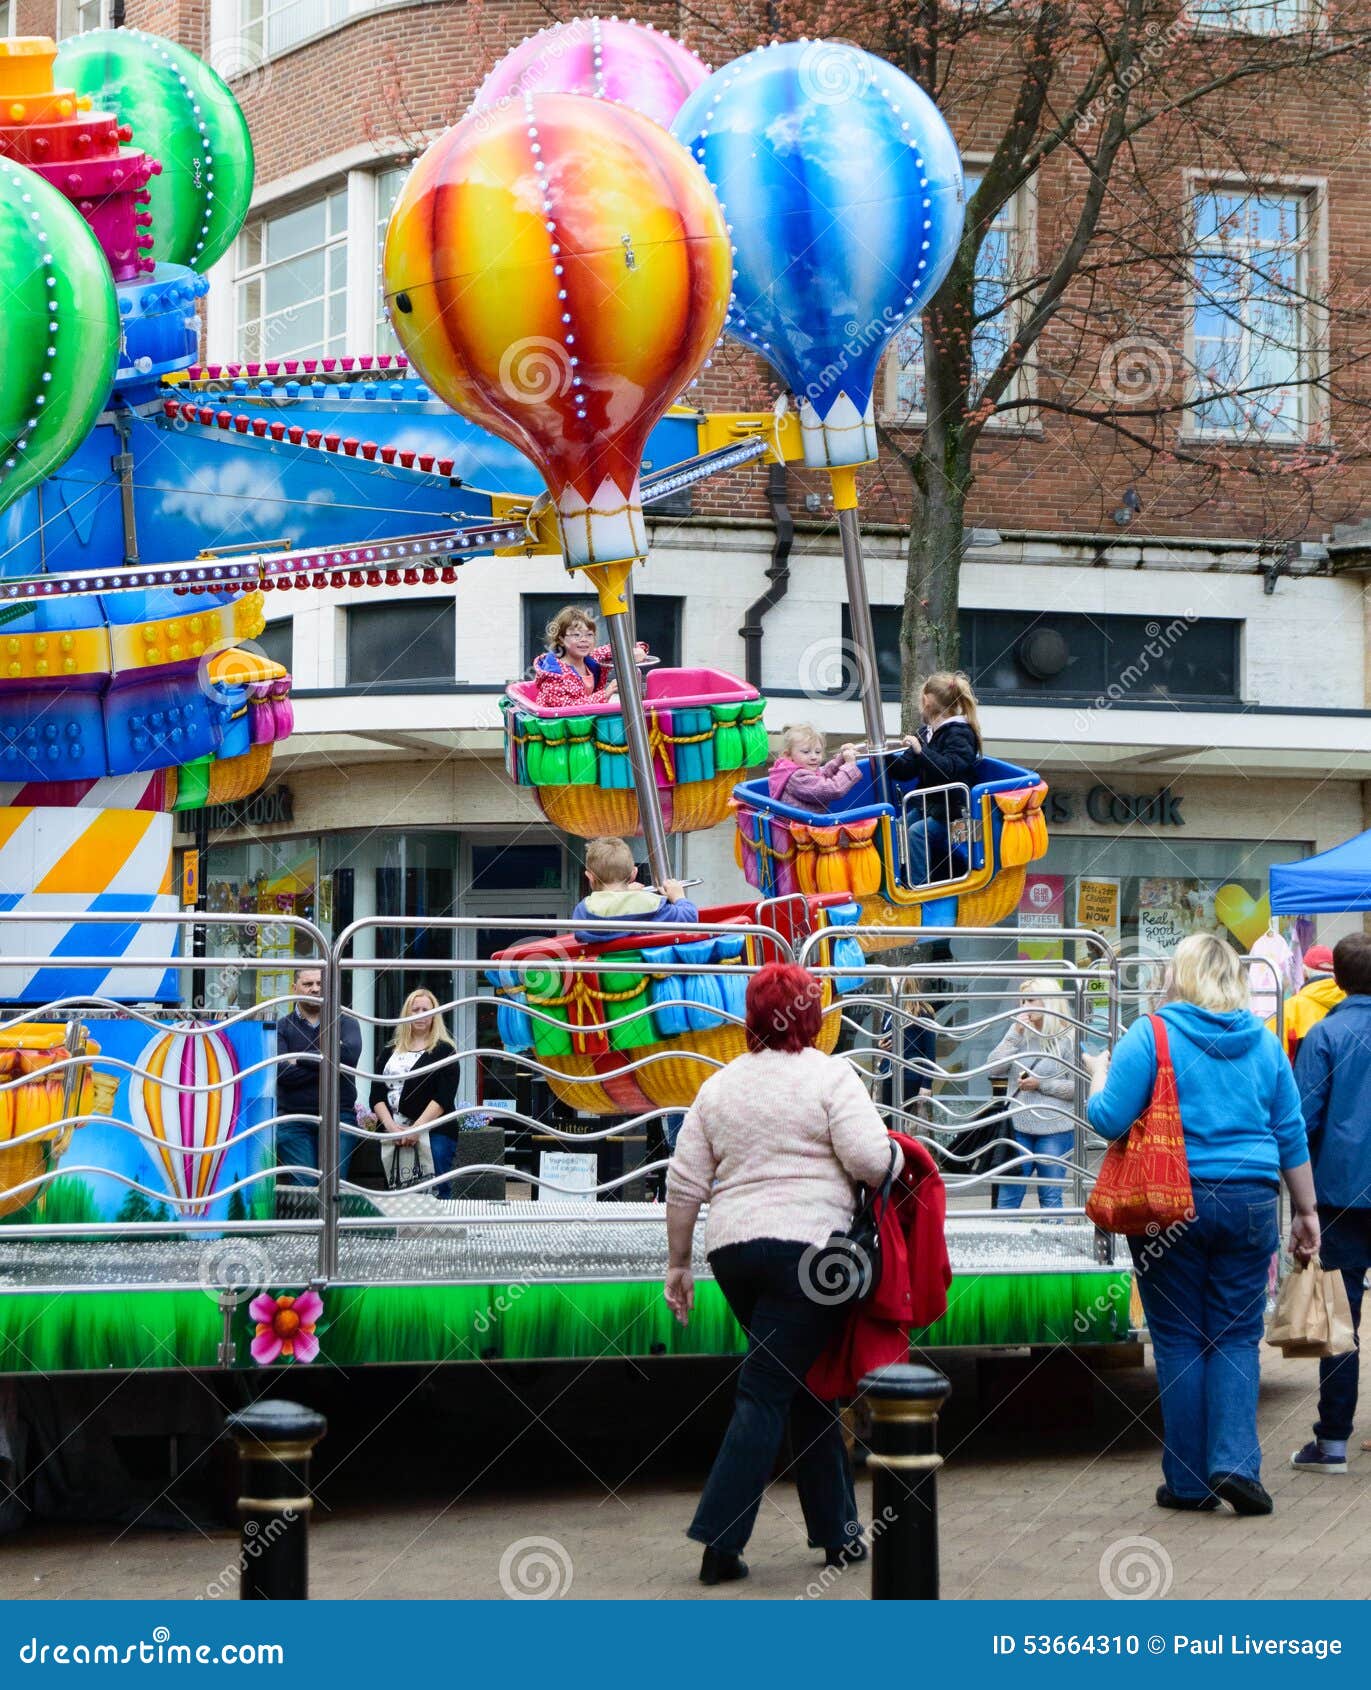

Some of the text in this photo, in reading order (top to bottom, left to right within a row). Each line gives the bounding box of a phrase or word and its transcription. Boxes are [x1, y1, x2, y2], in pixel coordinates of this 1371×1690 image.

[1086, 785, 1186, 825] Cook
[1086, 912, 1110, 923] NOW
[1142, 911, 1169, 926] Real
[1145, 921, 1182, 942] good
